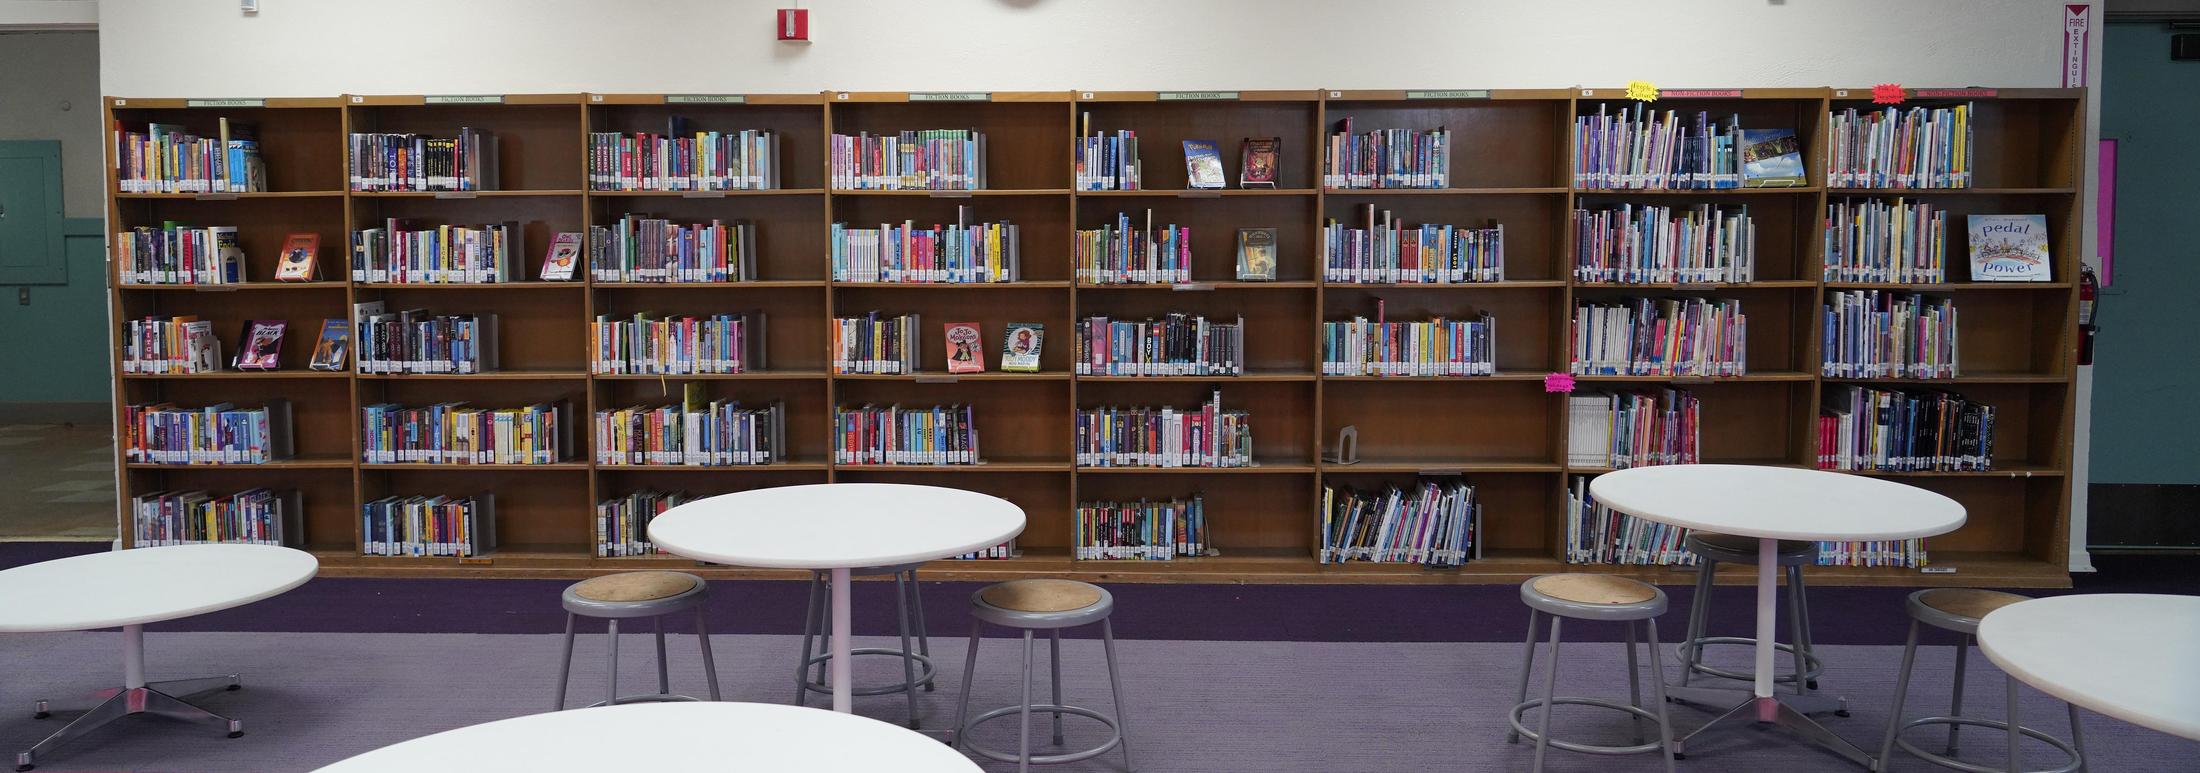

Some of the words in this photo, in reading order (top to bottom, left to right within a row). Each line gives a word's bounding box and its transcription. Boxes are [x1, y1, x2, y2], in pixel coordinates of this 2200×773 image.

[2069, 18, 2084, 27] FIRE
[1983, 222, 2030, 237] pedal
[1983, 262, 2034, 273] power
